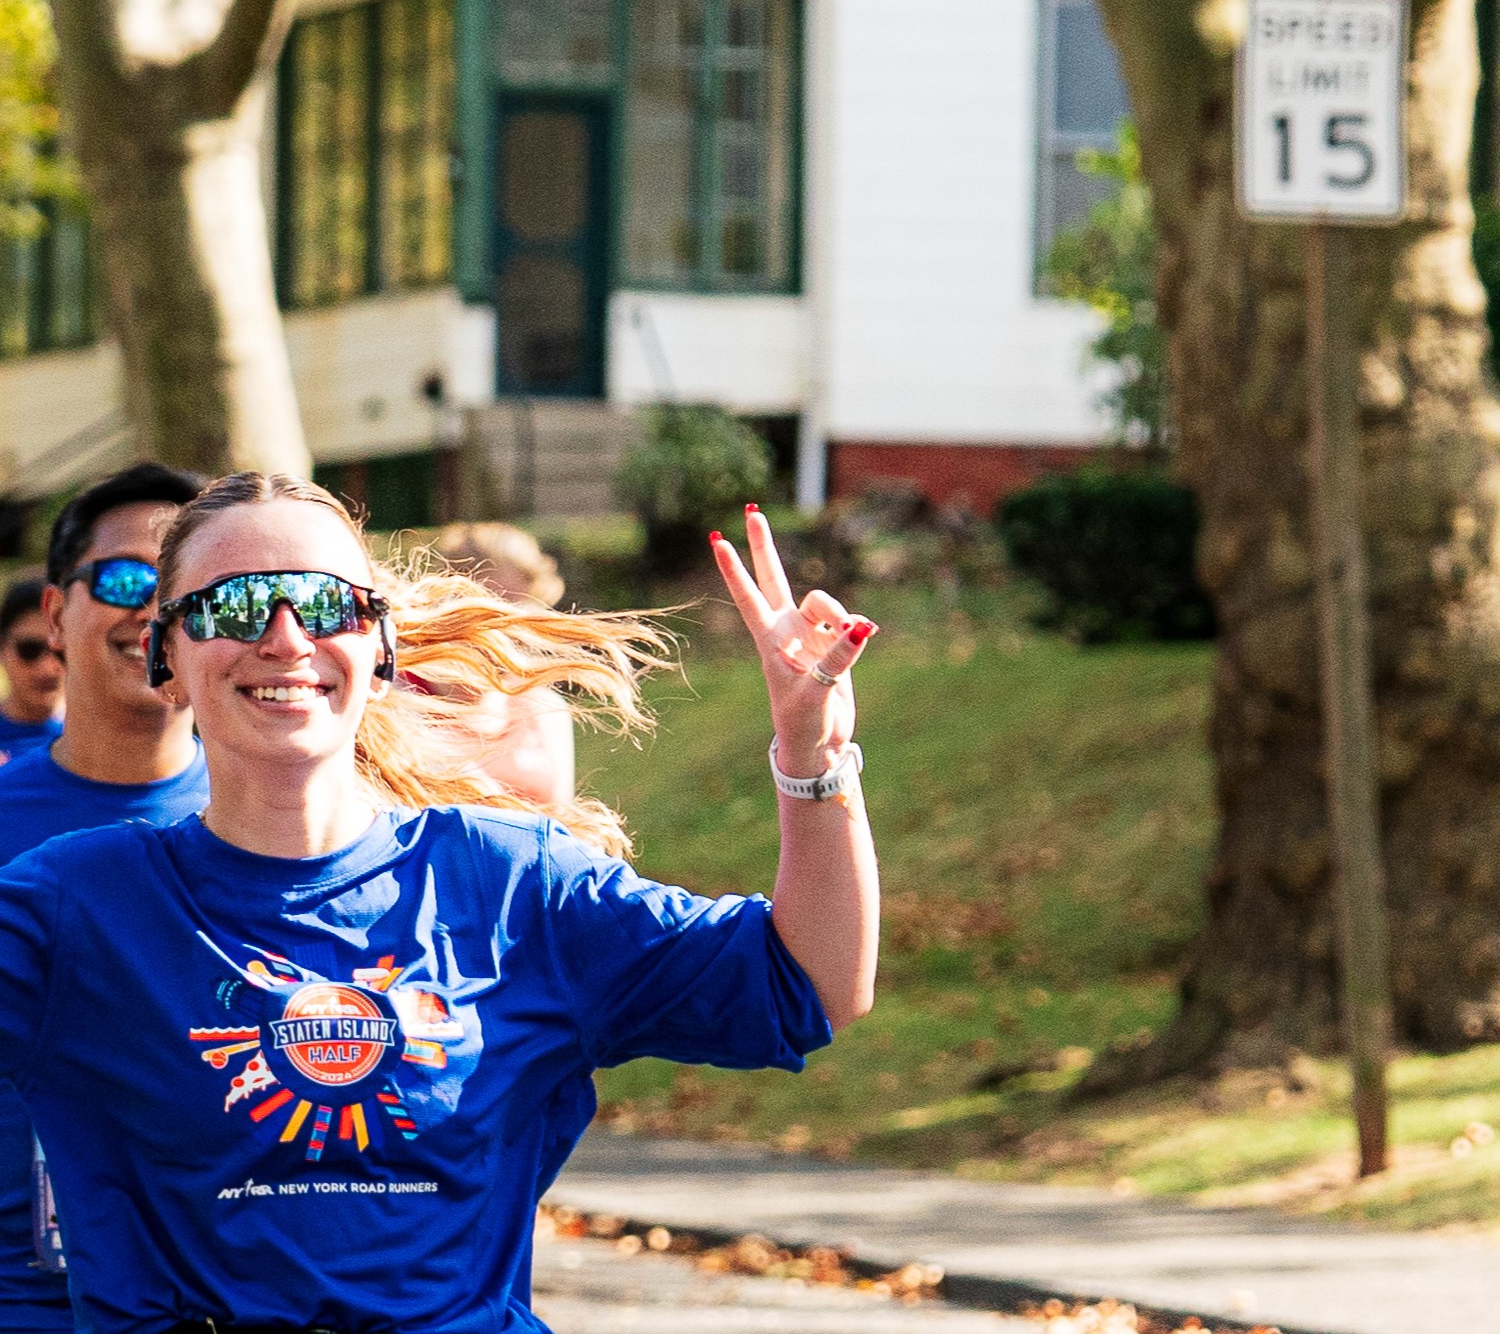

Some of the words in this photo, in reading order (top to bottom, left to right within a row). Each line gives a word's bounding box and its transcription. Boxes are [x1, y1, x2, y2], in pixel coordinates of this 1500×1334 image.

[1258, 12, 1395, 49] SPEED
[1267, 62, 1371, 91] LIMIT
[1273, 113, 1376, 190] 15
[278, 1019, 331, 1044] STATEN
[337, 1020, 389, 1041] ISLAND
[308, 1045, 361, 1063] HALF
[279, 1184, 309, 1194] NEW
[313, 1183, 348, 1193] YORK
[351, 1183, 386, 1193] ROAD
[388, 1182, 438, 1193] RUNNERS
